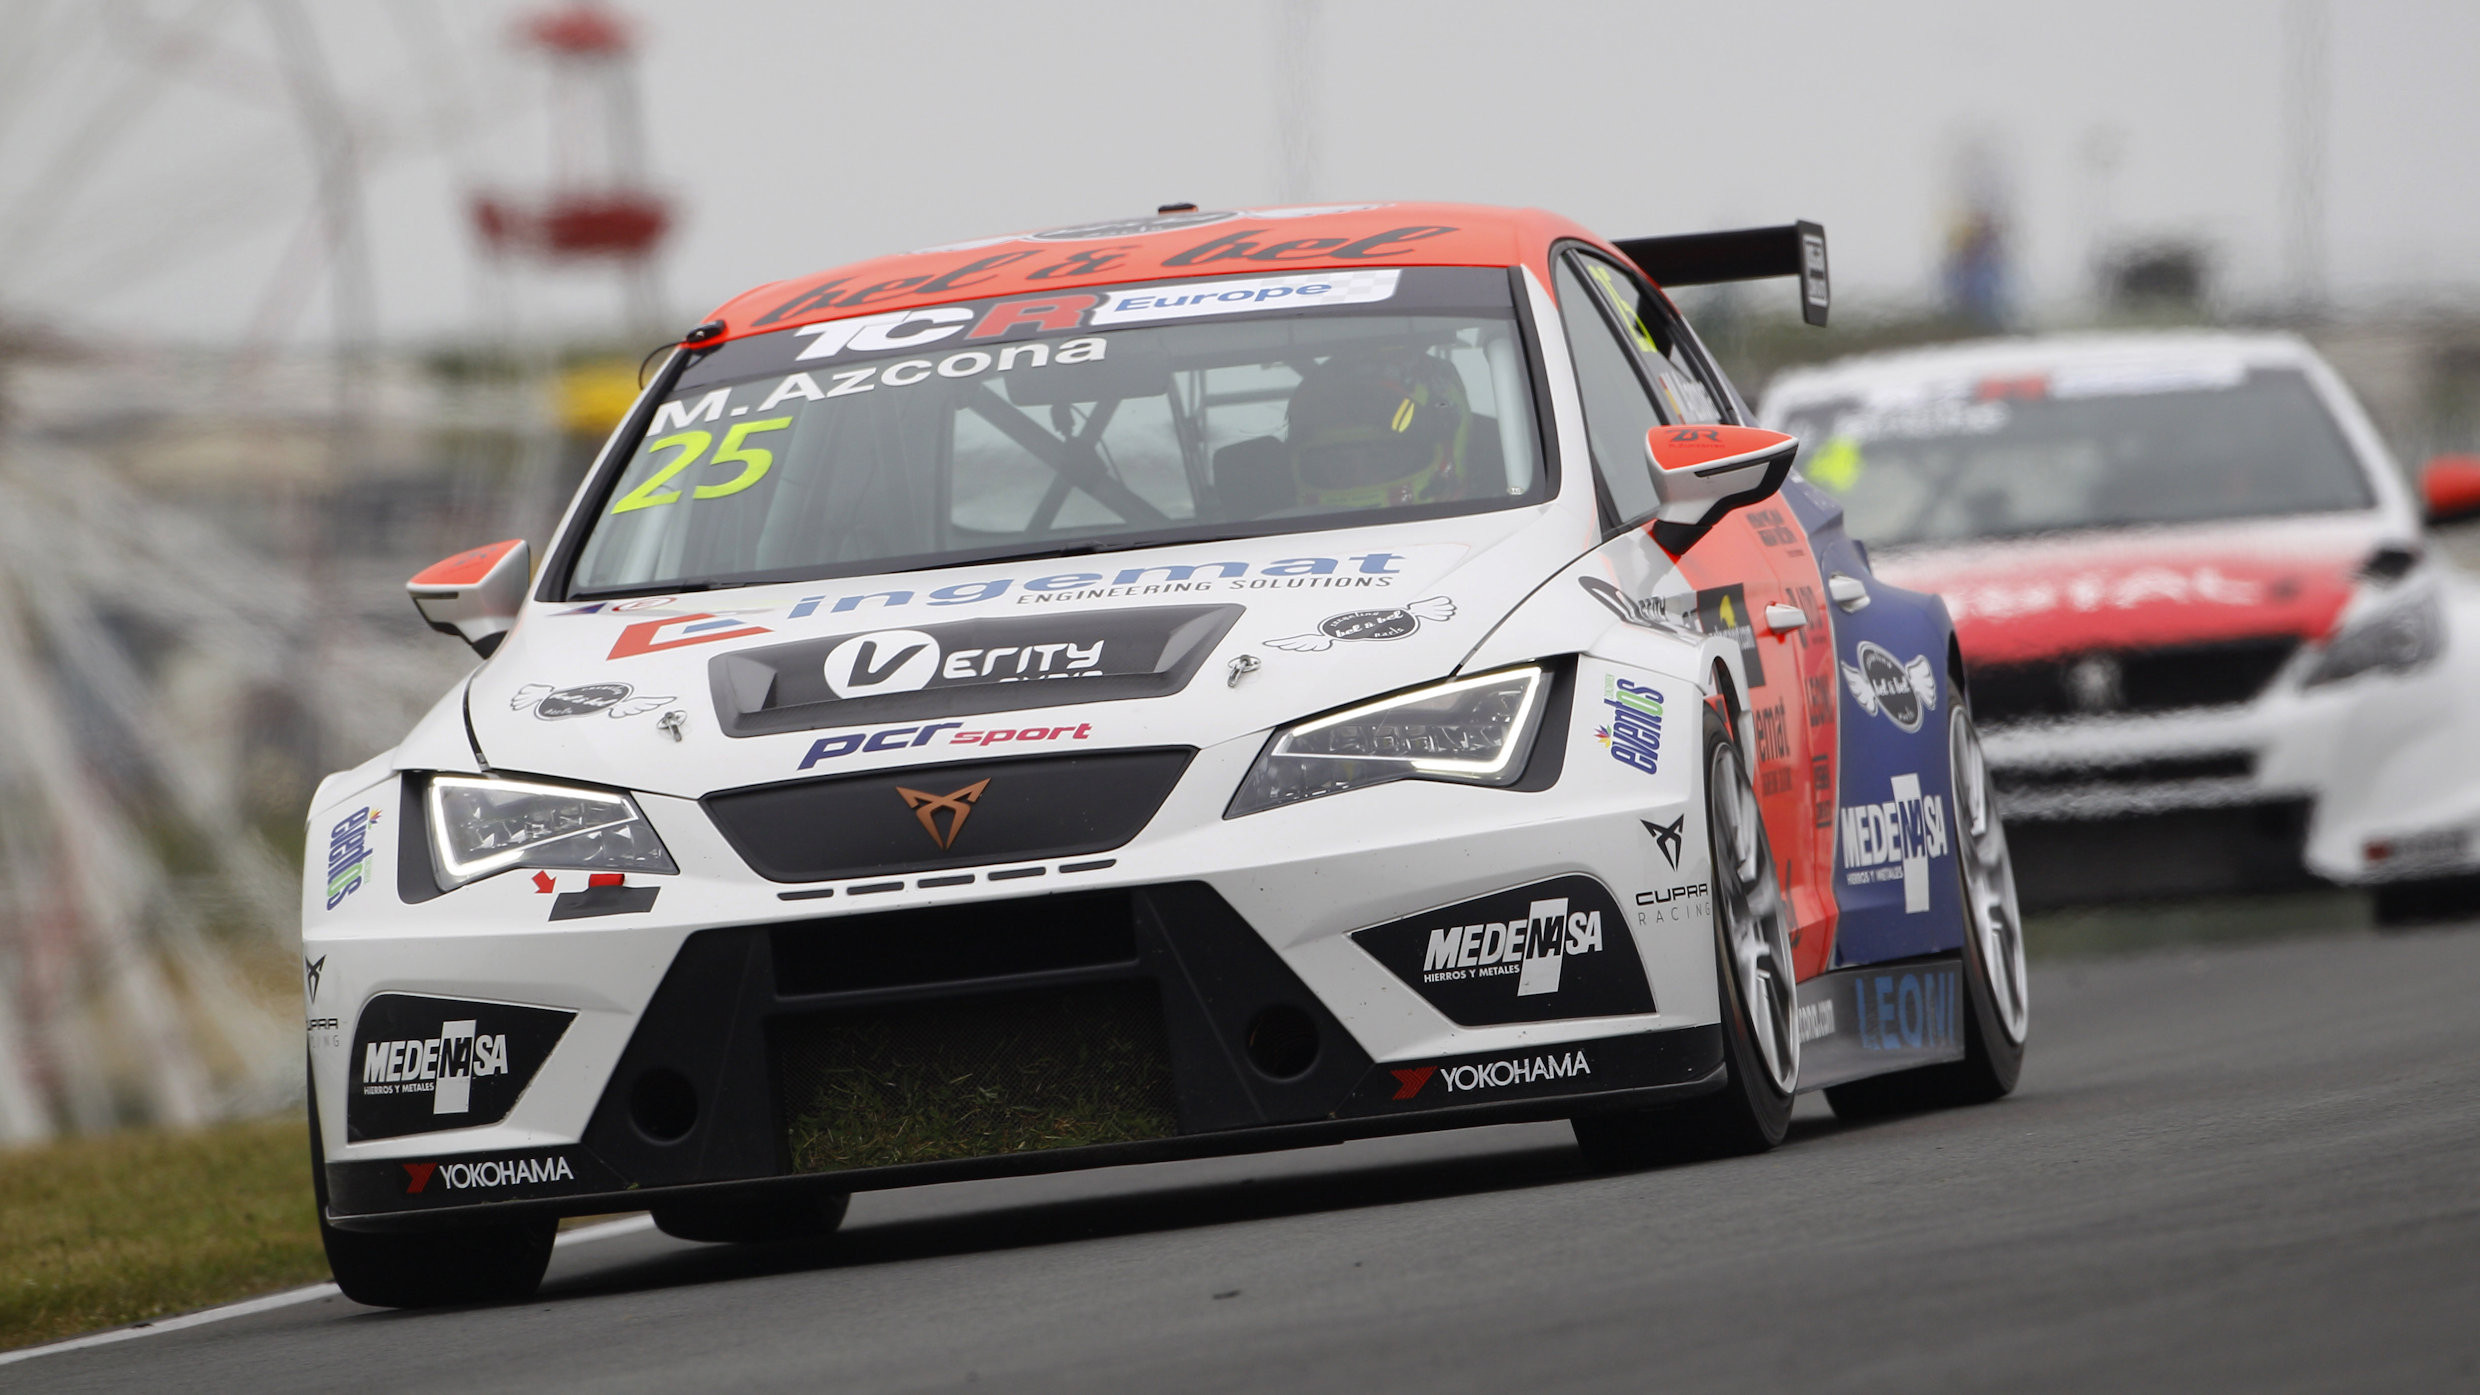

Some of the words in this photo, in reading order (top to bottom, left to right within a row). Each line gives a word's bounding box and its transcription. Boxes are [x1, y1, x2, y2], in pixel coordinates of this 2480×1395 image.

[751, 250, 1045, 327] bel
[1161, 226, 1460, 267] bel
[794, 295, 1099, 361] TCR
[1114, 282, 1332, 312] Europe
[758, 337, 1108, 412] Azcona
[610, 416, 793, 515] 25
[787, 553, 1406, 619] ingemat
[1017, 580, 1211, 604] ENGINEERING
[1229, 576, 1393, 591] SOLUTIONS
[1604, 678, 1664, 775] eventos
[1841, 794, 1948, 869] MEDENASA
[1636, 883, 1708, 906] CUPRA
[1638, 902, 1711, 926] RACING
[1423, 910, 1603, 971] MEDENASA
[1424, 970, 1467, 983] HIERROS
[1478, 964, 1520, 977] METALES
[1855, 972, 1955, 1050] LEONI
[363, 1034, 509, 1084] MEDENASA
[364, 1084, 393, 1095] HIERROS
[402, 1082, 435, 1093] METALES
[1441, 1050, 1591, 1092] YOKOHAMA
[439, 1156, 574, 1190] YOKOHAMA
